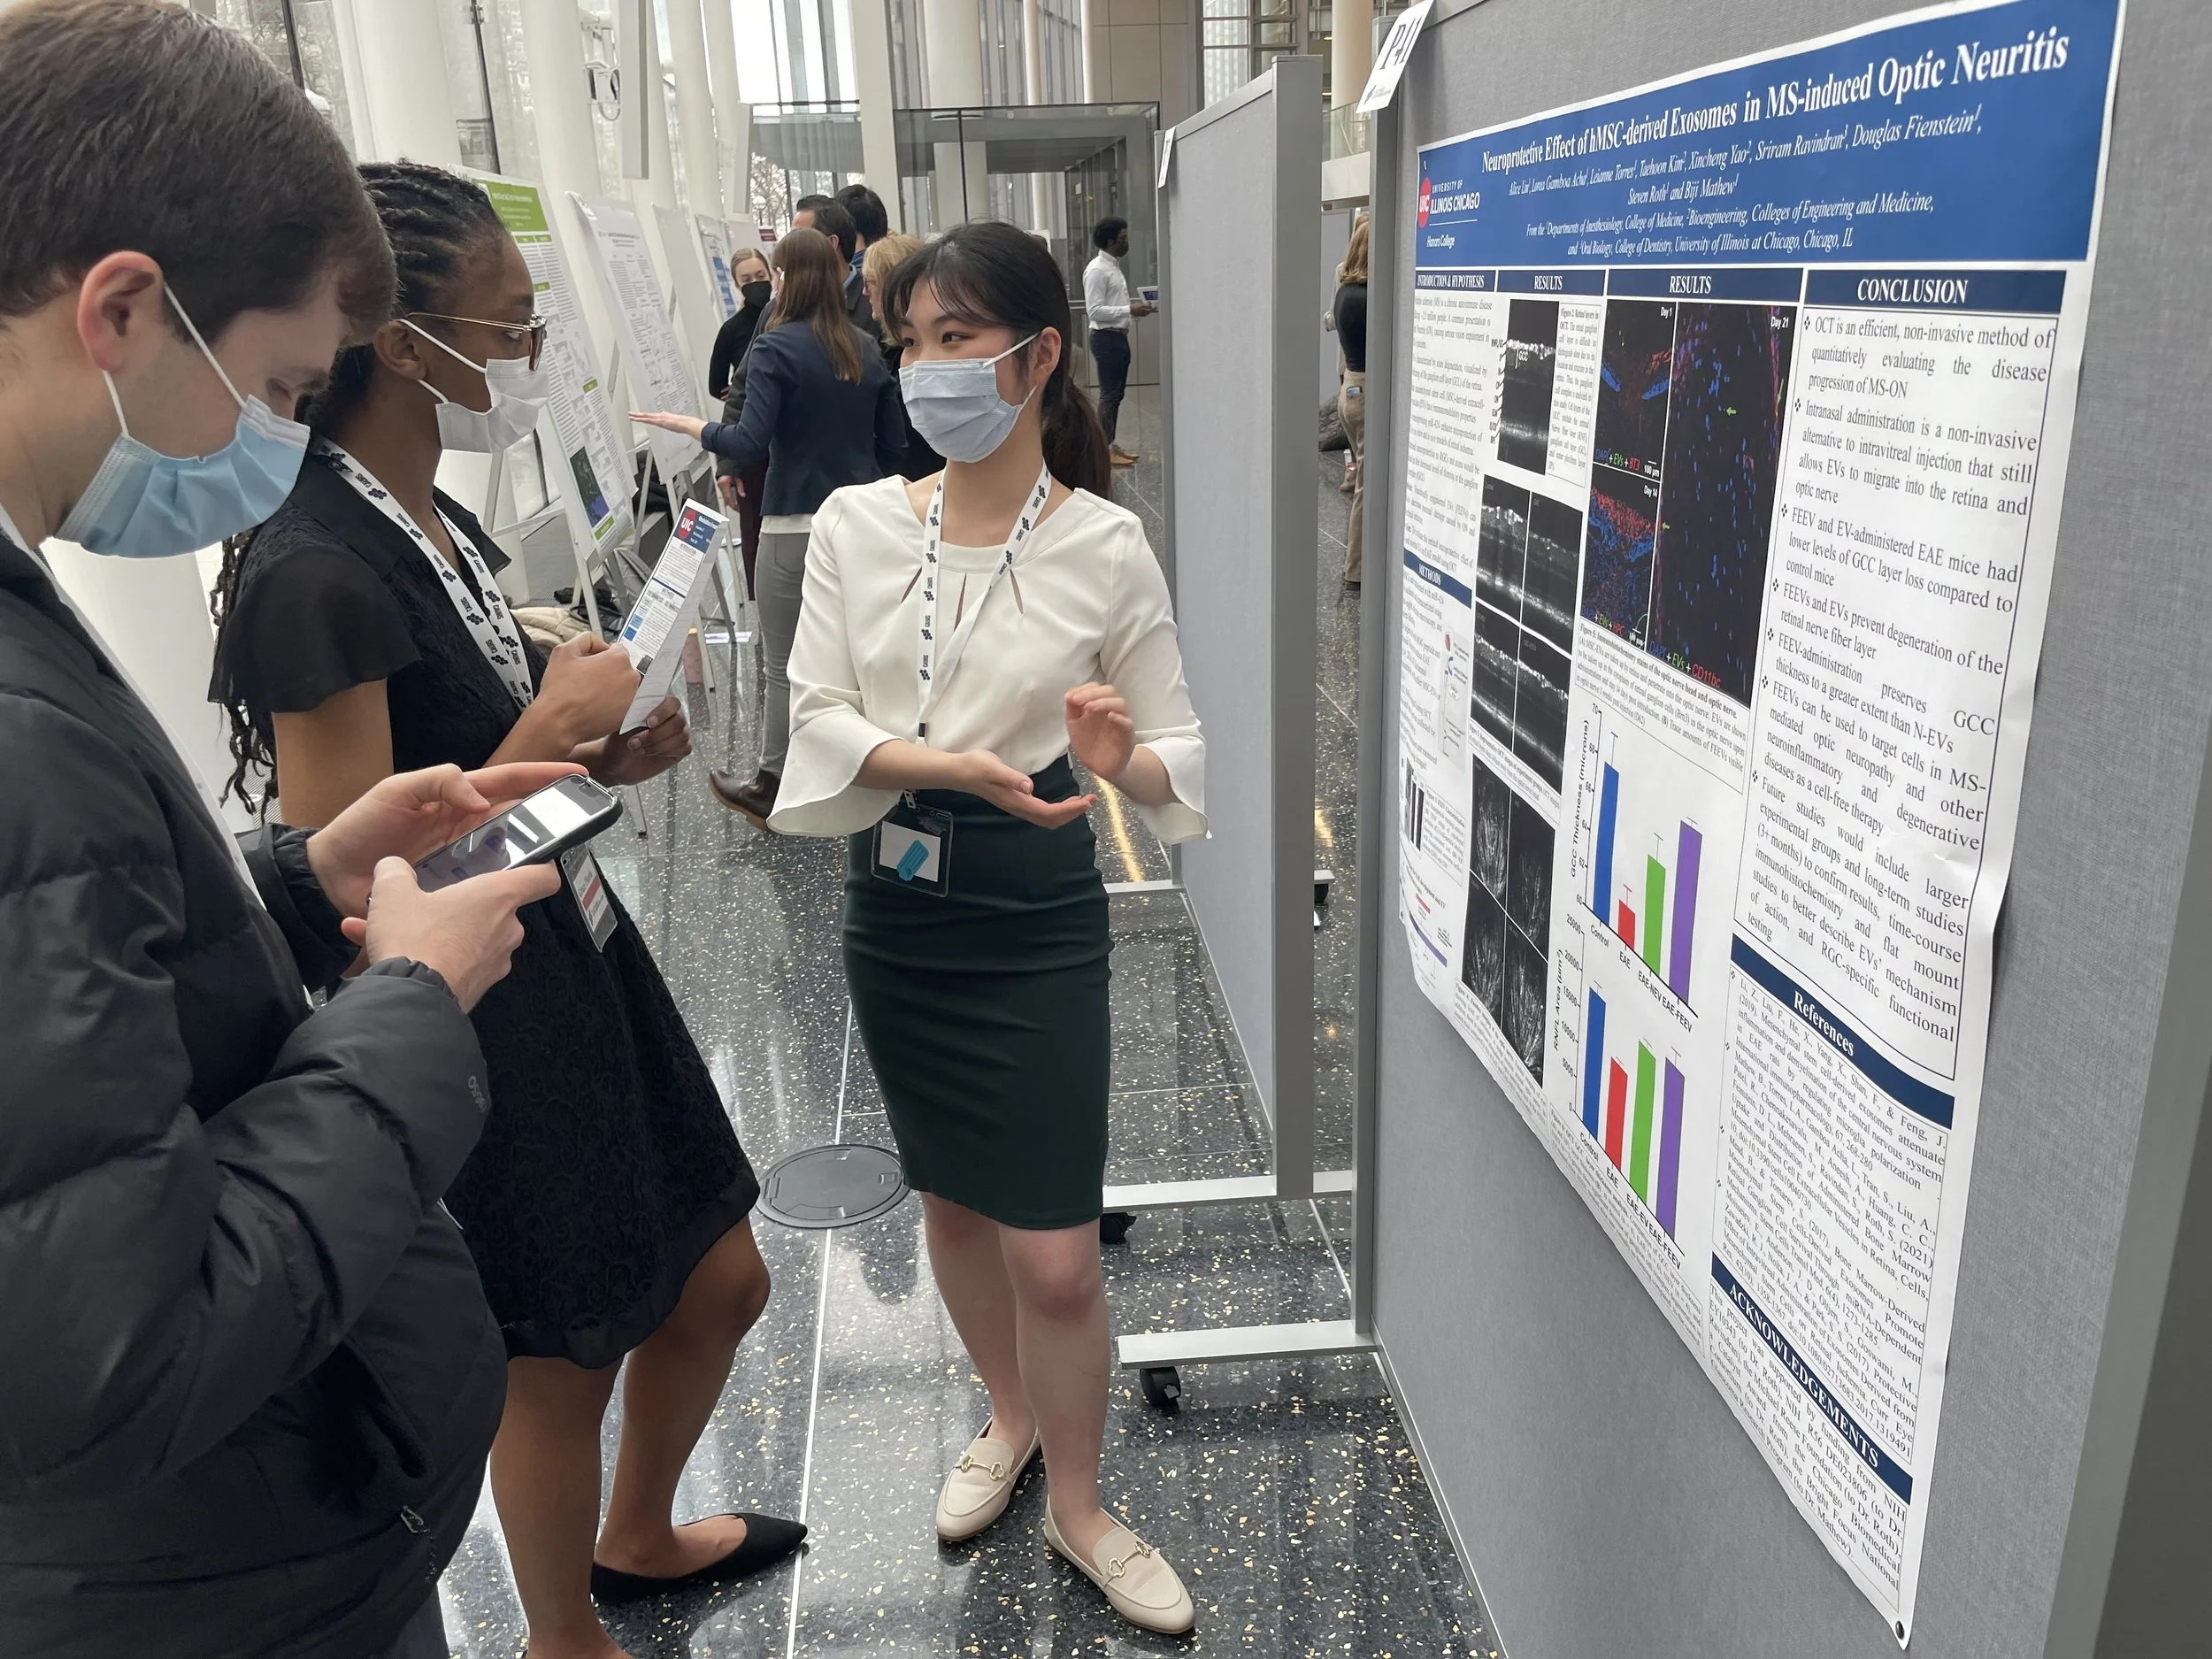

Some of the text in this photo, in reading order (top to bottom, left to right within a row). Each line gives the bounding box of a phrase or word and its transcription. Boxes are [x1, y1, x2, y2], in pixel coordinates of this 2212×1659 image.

[1482, 26, 2070, 175] Neuroprotective Effect of hMSC-derived Exosomes in MS-induced Optic Neuritis
[1689, 119, 1902, 171] Xincheng Sriram Douglas
[1419, 195, 1431, 212] UIC
[1430, 192, 1480, 215] ILLINOIS CHICAGO
[1432, 180, 1463, 194] UNIVERSITY OF
[1628, 180, 1699, 205] Steven and Biji
[1752, 191, 1934, 226] Colleges of Engineering and Medicine,
[1427, 235, 1455, 249] Honors College
[1616, 227, 1854, 258] College Dentistry, University of Illinois at Chicago, Chicago, IL
[1451, 275, 1485, 288] HYPOTHESIS
[1534, 276, 1563, 290] RESULTS
[1670, 276, 1712, 294] RESULTS
[1857, 278, 1968, 303] CONCLUSION
[1770, 316, 1789, 328] Day 21
[1816, 316, 2056, 349] OCT is an efficient, non-invasive method of
[1811, 346, 2047, 382] quantitatively evaluating the disease
[1809, 373, 1908, 399] progression of MS-ON
[1806, 400, 2037, 451] Intranasal administration is a non-invasive
[1802, 427, 2032, 484] alternative to intravitreal injection that still
[1644, 486, 1653, 495] Day
[1795, 479, 1839, 503] optic nerve
[1799, 453, 2028, 516] allows EVs to migrate into the retina and
[680, 517, 695, 532] UIC
[1792, 507, 2018, 583] FEEV and EV-administered EAE mice had
[1418, 564, 1441, 586] METHODS
[1786, 558, 1834, 587] control mice
[1789, 531, 2013, 613] lower levels of GCC layer loss compared to
[1780, 608, 1877, 660] retinal nerve fiber layer
[1784, 582, 2003, 675] FEEVs and EVs prevent degeneration of the
[1672, 653, 1721, 688] EVs CD11bc
[1778, 633, 1994, 734] FEEV-administration preserves GCC
[1685, 684, 1697, 698] head
[1698, 689, 1708, 702] and
[1709, 694, 1722, 710] optic
[1573, 720, 1590, 847] Thickness (microns)
[1950, 768, 1986, 792] MS-
[1897, 803, 1979, 850] degenerative
[1940, 799, 1985, 823] other
[1926, 879, 1970, 910] larger
[1590, 924, 1610, 949] Control
[1916, 905, 1964, 937] studies
[1889, 913, 1962, 963] time-course
[1619, 950, 1631, 971] EAE
[1914, 960, 1960, 990] mount
[1886, 967, 1956, 1017] mechanism
[1662, 1001, 1692, 1035] EAE-FEEV
[1793, 990, 1855, 1057] References
[1889, 995, 1955, 1043] functional
[1898, 1133, 1945, 1166] attenuate
[1892, 1249, 1932, 1284] Marrow
[1730, 1283, 1879, 1467] ACKNOWLEDGEMENTS
[1821, 1422, 1907, 1522] funding from NIH
[1851, 1514, 1901, 1574] Biomedical
[1862, 1543, 1899, 1589] National
